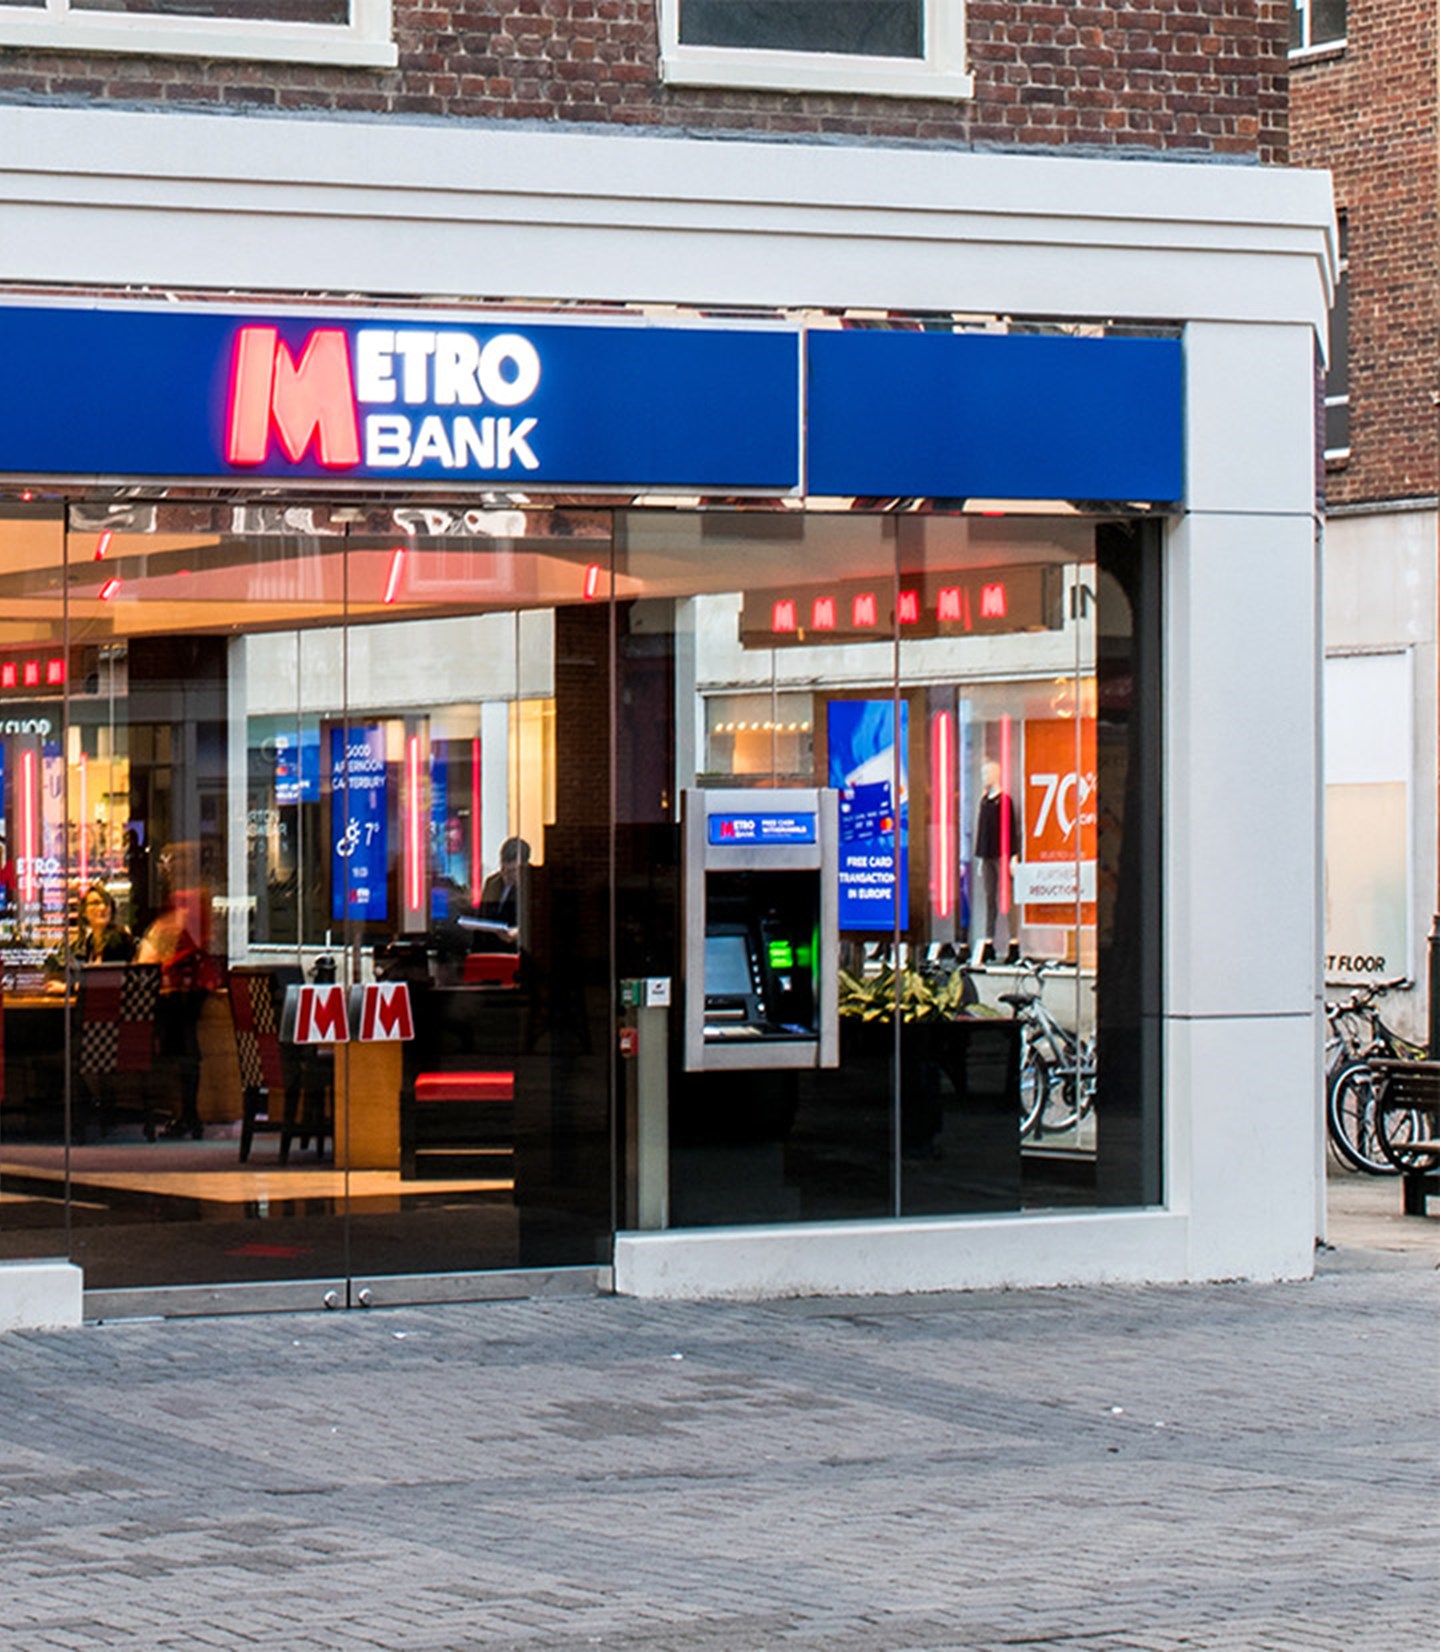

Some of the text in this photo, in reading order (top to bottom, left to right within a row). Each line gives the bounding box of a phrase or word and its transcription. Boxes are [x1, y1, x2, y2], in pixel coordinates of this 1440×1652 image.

[226, 325, 541, 468] METRO
[365, 415, 540, 469] BANK
[334, 759, 384, 774] AFERNOON
[332, 775, 387, 791] CATERBURY
[846, 856, 893, 867] FREE CARD
[848, 888, 892, 899] IN EUROPE
[1337, 955, 1386, 972] FLOOR
